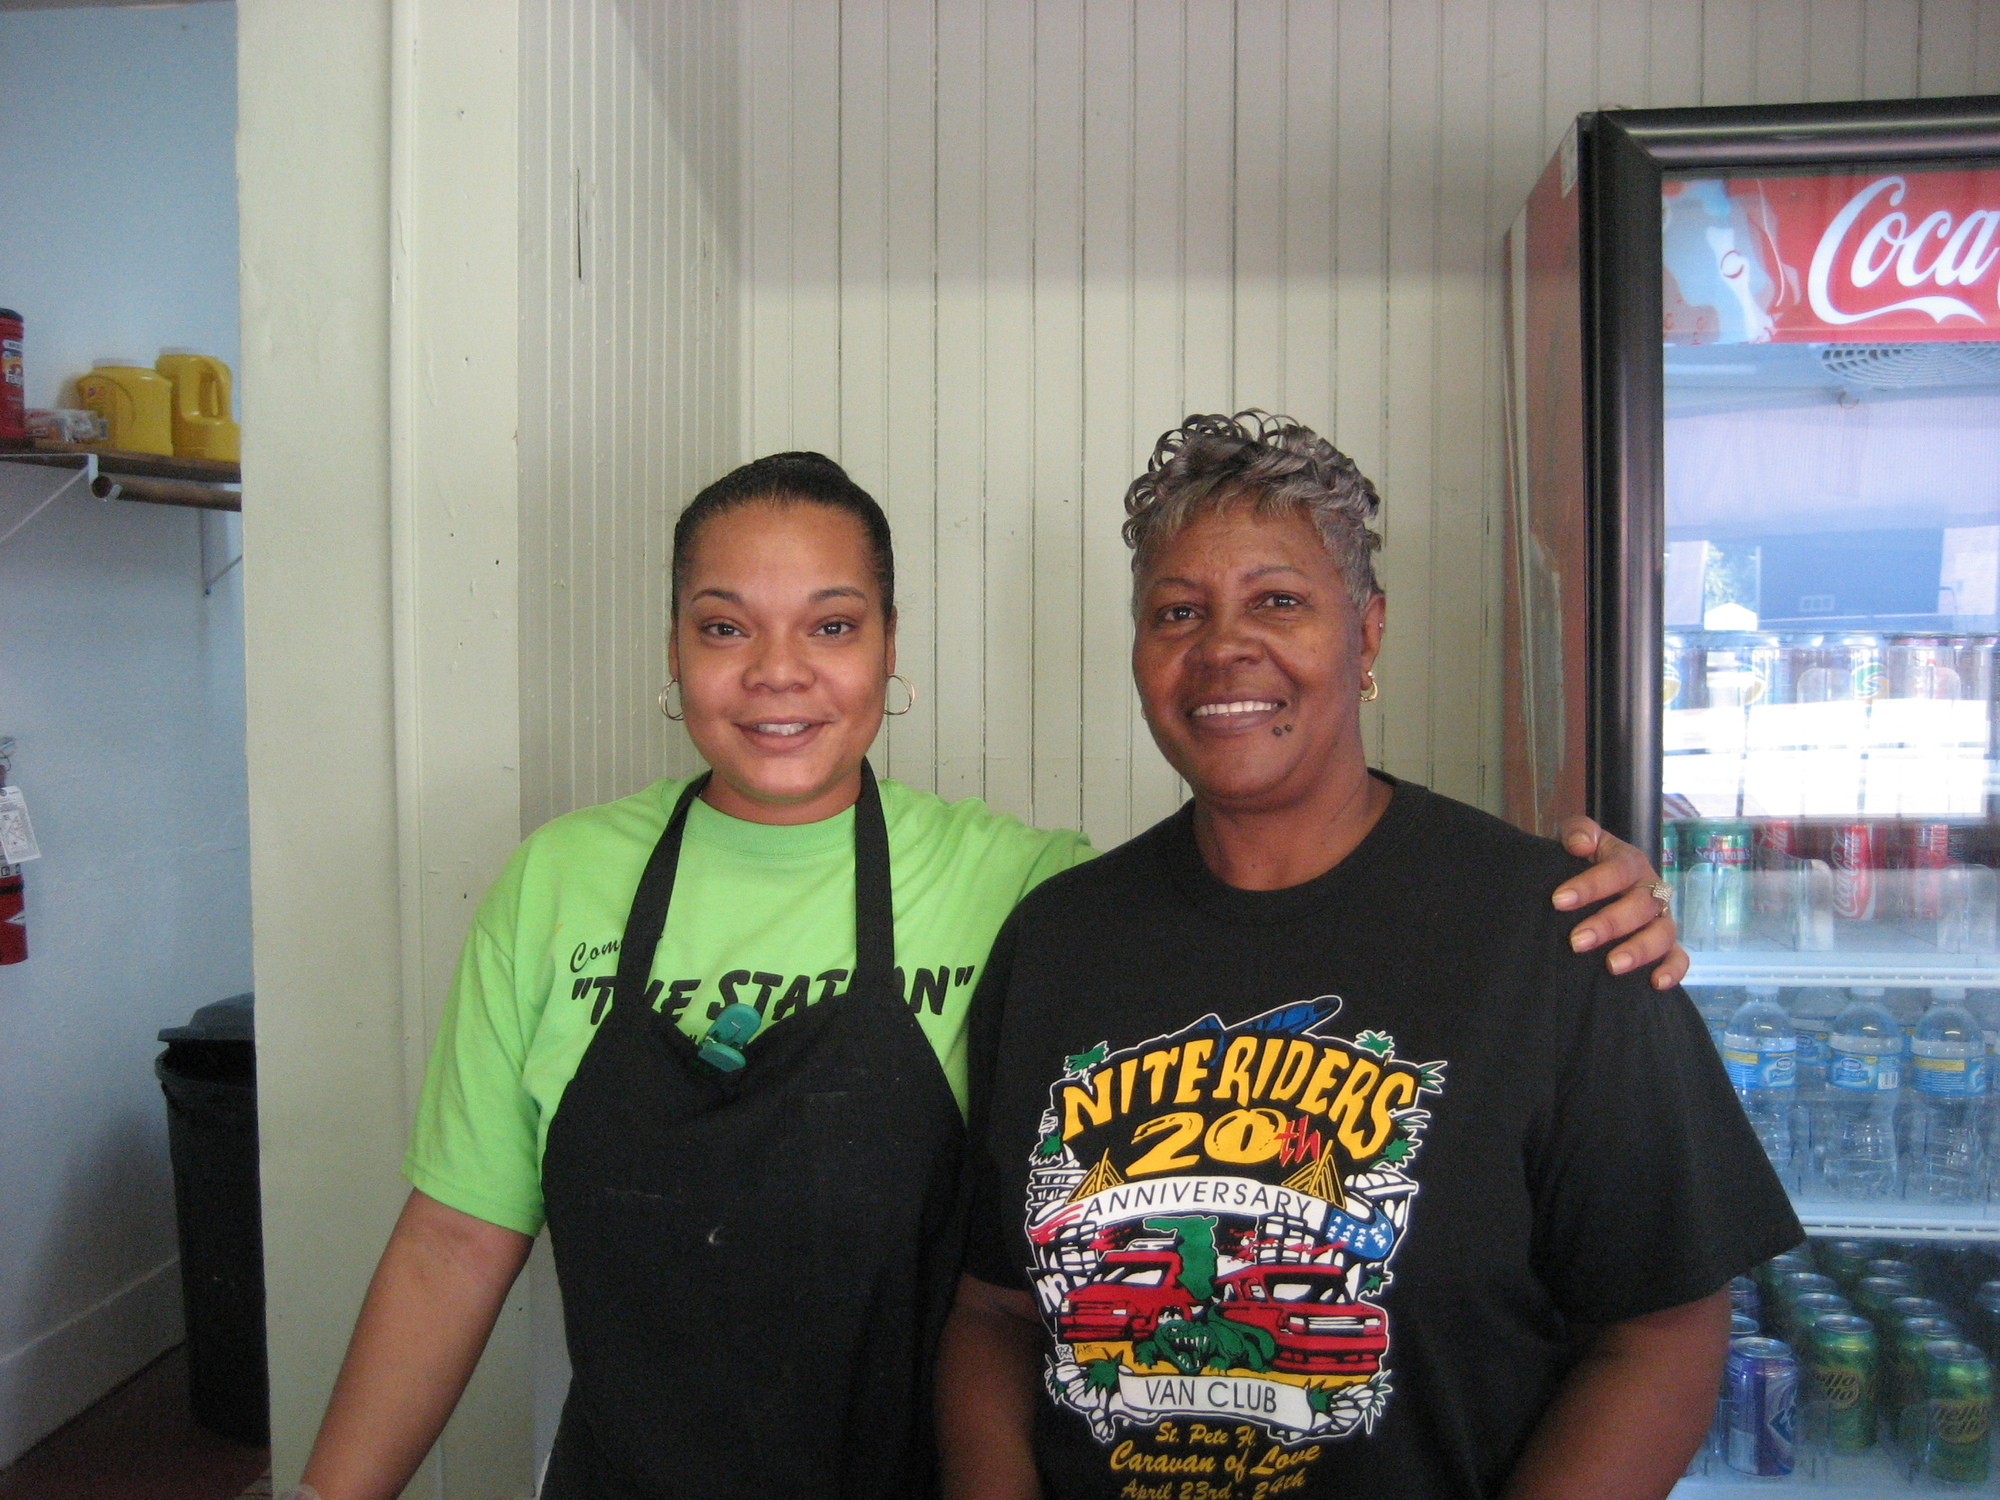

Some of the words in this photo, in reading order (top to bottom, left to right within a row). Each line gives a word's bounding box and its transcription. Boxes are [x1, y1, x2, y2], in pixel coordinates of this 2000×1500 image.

[570, 939, 623, 973] Com
[706, 966, 976, 1022] STATN"
[1061, 1039, 1214, 1142] NITE
[1212, 1036, 1416, 1160] RIDERS
[1125, 1107, 1321, 1177] 20th
[1082, 1182, 1312, 1222] ANNIVERSARY
[1145, 1380, 1196, 1407] VAN
[1207, 1381, 1278, 1414] CLUB
[1155, 1421, 1180, 1443] St.
[1189, 1423, 1230, 1445] Pete
[1110, 1440, 1216, 1474] Caravan
[1224, 1447, 1251, 1484] of
[1249, 1445, 1322, 1475] Love
[1120, 1478, 1173, 1500] April
[1178, 1481, 1232, 1500] 23rd
